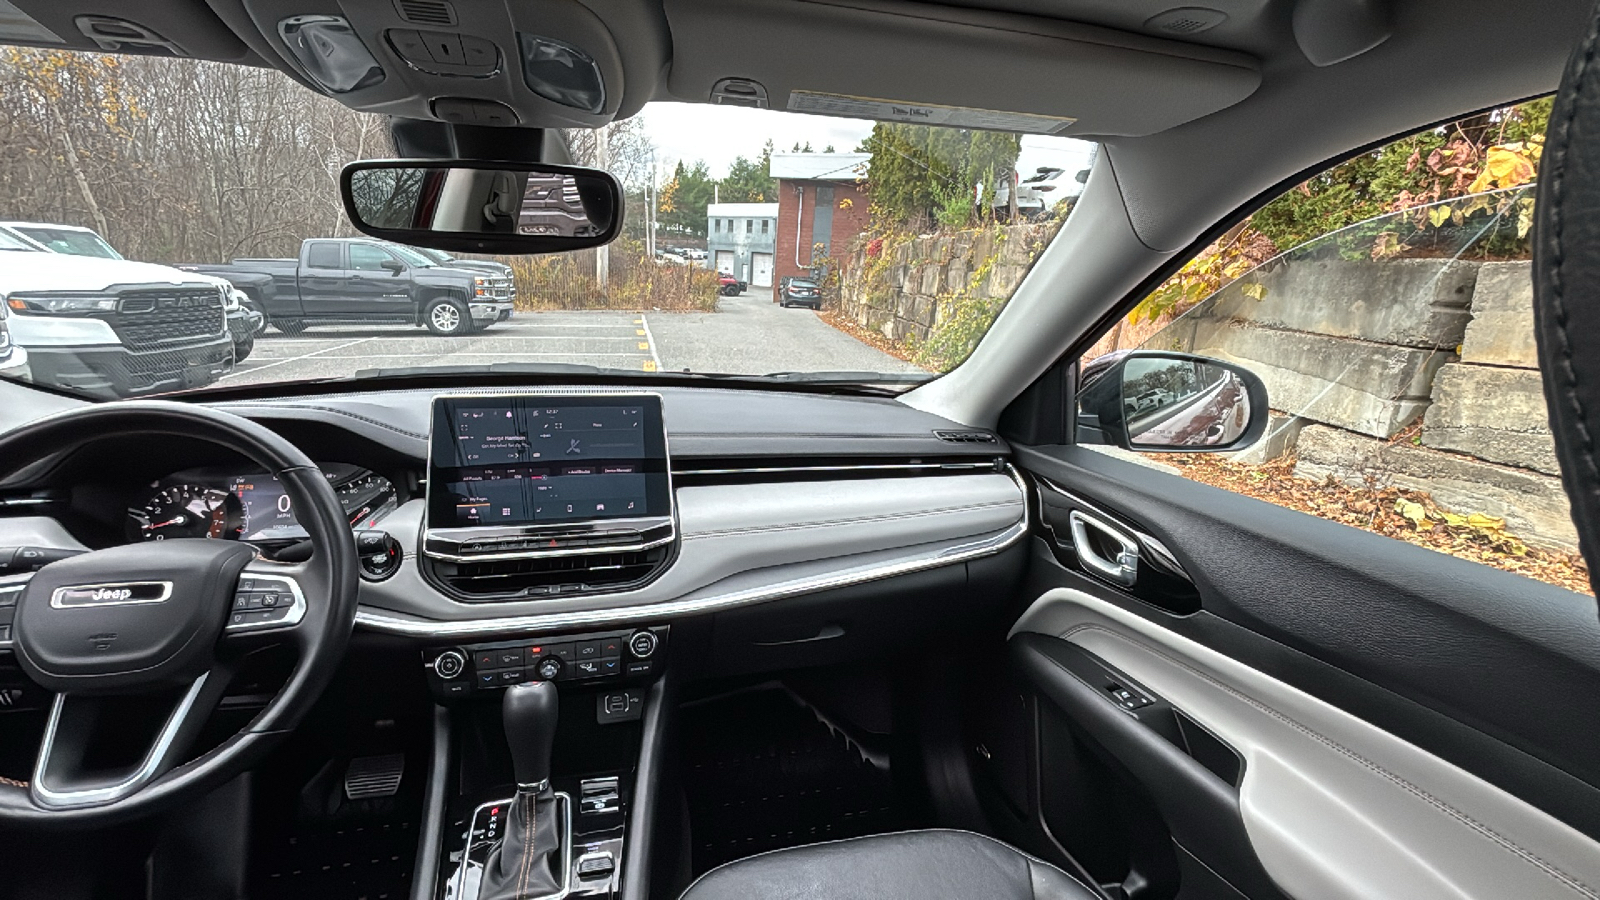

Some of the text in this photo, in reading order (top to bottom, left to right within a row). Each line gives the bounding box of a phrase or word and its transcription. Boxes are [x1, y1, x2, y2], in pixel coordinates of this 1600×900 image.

[165, 496, 173, 504] 3
[277, 494, 291, 513] 0
[154, 506, 162, 514] 2
[92, 588, 132, 601] Jeep
[491, 807, 498, 815] P
